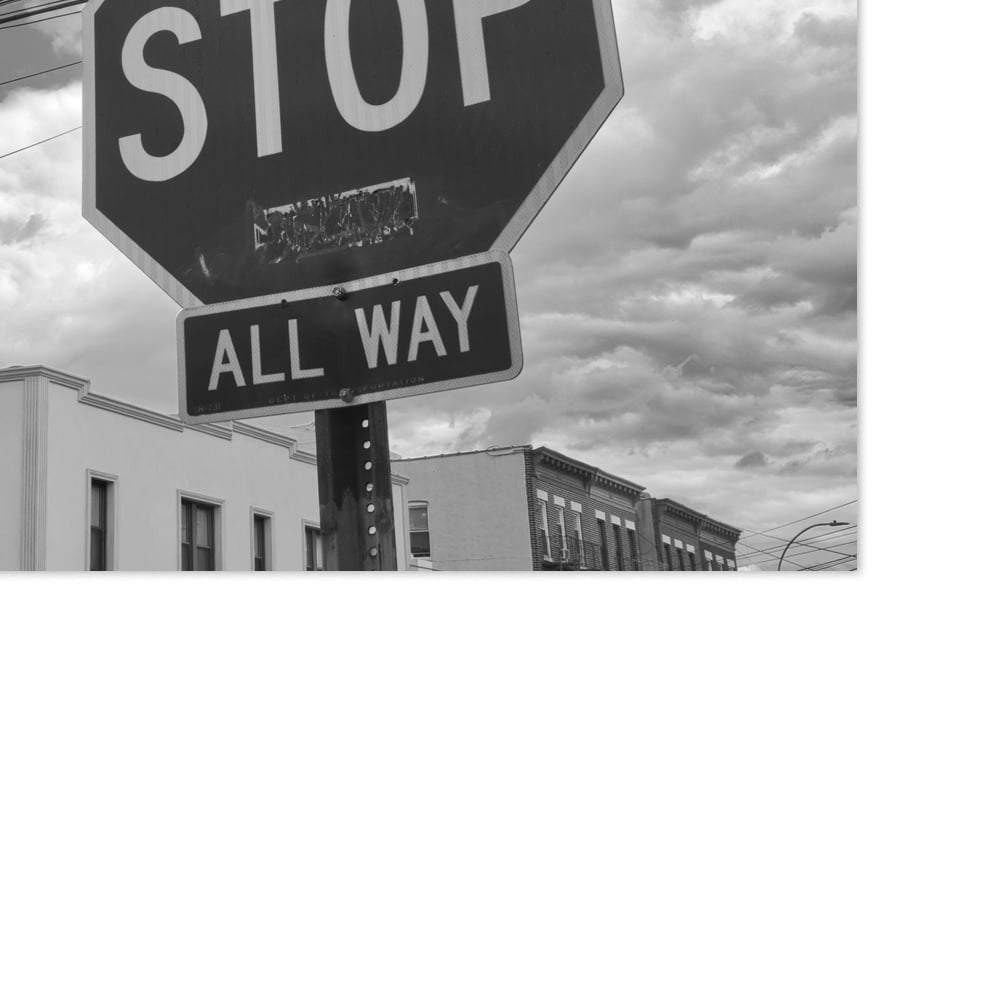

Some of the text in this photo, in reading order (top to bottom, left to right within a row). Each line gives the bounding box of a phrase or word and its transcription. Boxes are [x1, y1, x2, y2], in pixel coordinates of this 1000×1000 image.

[207, 284, 480, 391] ALL WAY
[303, 392, 316, 400] OF
